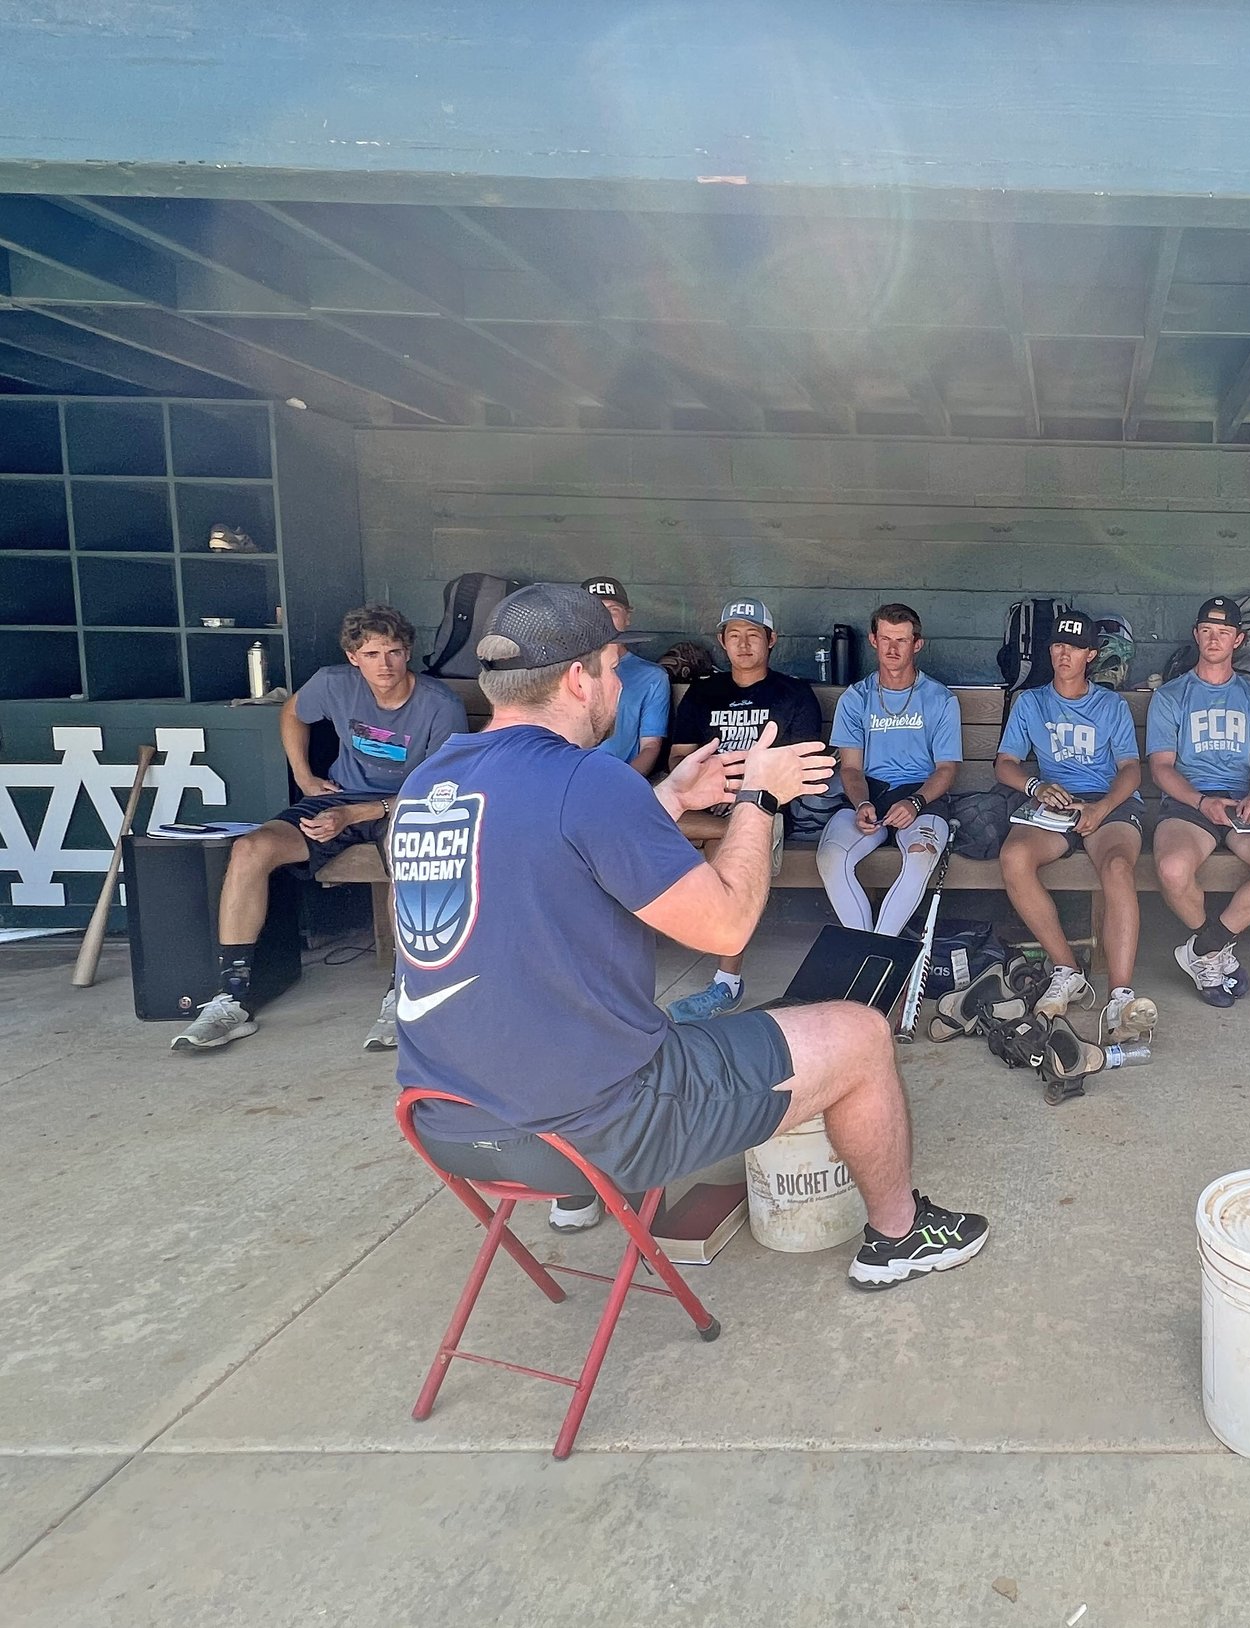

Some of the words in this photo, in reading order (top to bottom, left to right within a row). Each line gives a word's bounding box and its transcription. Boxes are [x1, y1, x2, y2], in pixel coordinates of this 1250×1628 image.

[588, 582, 616, 595] FCA
[729, 603, 755, 616] FCA
[1058, 620, 1083, 635] FCA
[709, 708, 770, 726] DEVELOP
[870, 712, 924, 733] hepherds
[1190, 708, 1246, 744] FCA
[719, 726, 759, 742] TRAIN
[1044, 721, 1097, 757] FCA
[394, 827, 470, 858] COACH
[395, 858, 467, 881] ACADEMY
[776, 1170, 829, 1196] BUCKET
